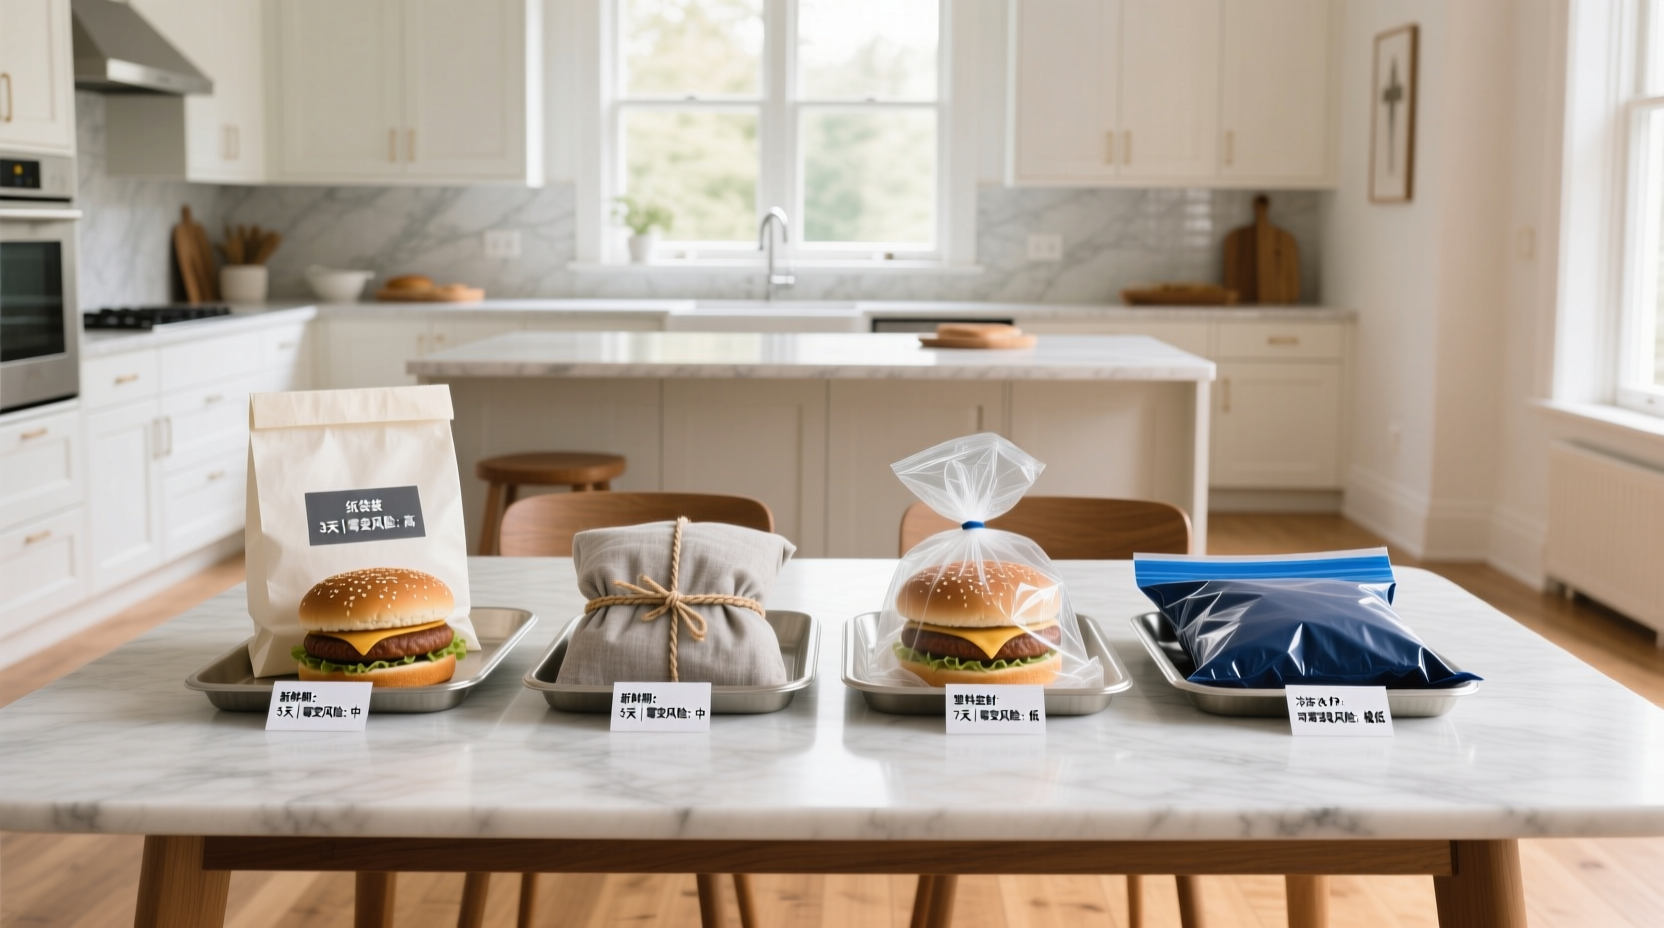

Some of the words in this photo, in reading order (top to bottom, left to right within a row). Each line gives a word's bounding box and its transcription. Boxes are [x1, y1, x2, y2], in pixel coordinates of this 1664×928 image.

[319, 520, 339, 534] 3天
[351, 703, 361, 719] 中
[695, 706, 706, 720] 中
[953, 709, 972, 722] 7天
